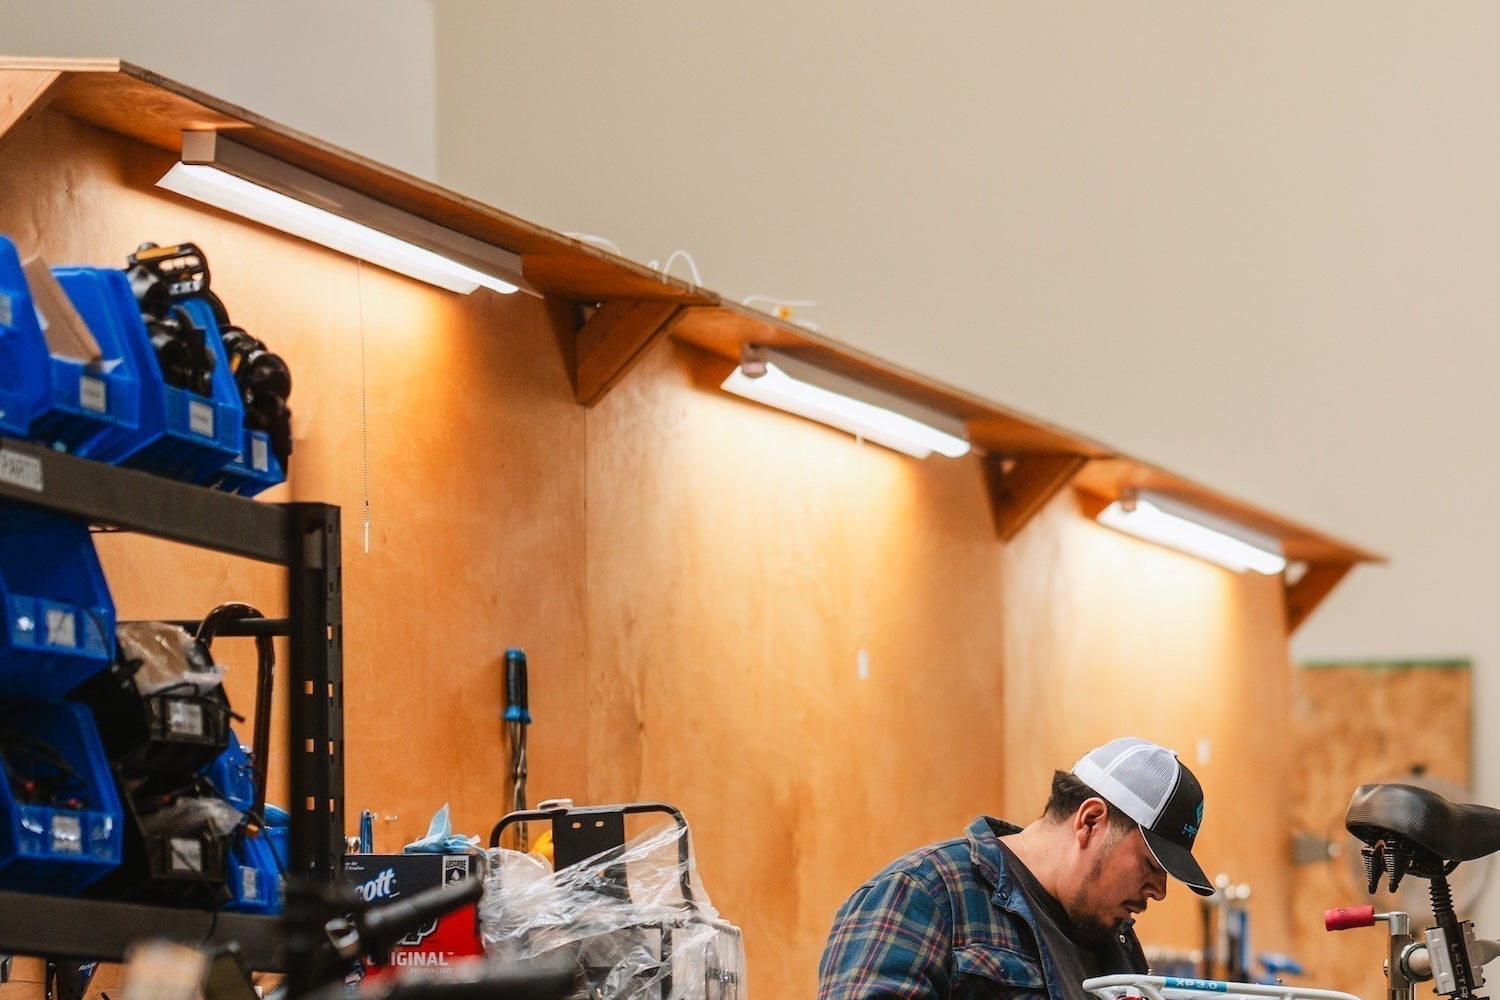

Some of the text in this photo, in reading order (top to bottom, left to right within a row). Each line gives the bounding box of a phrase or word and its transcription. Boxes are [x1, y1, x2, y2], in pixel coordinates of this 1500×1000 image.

[355, 868, 396, 902] cott
[1176, 979, 1218, 990] XP 3.0
[1451, 942, 1469, 998] LECTR
